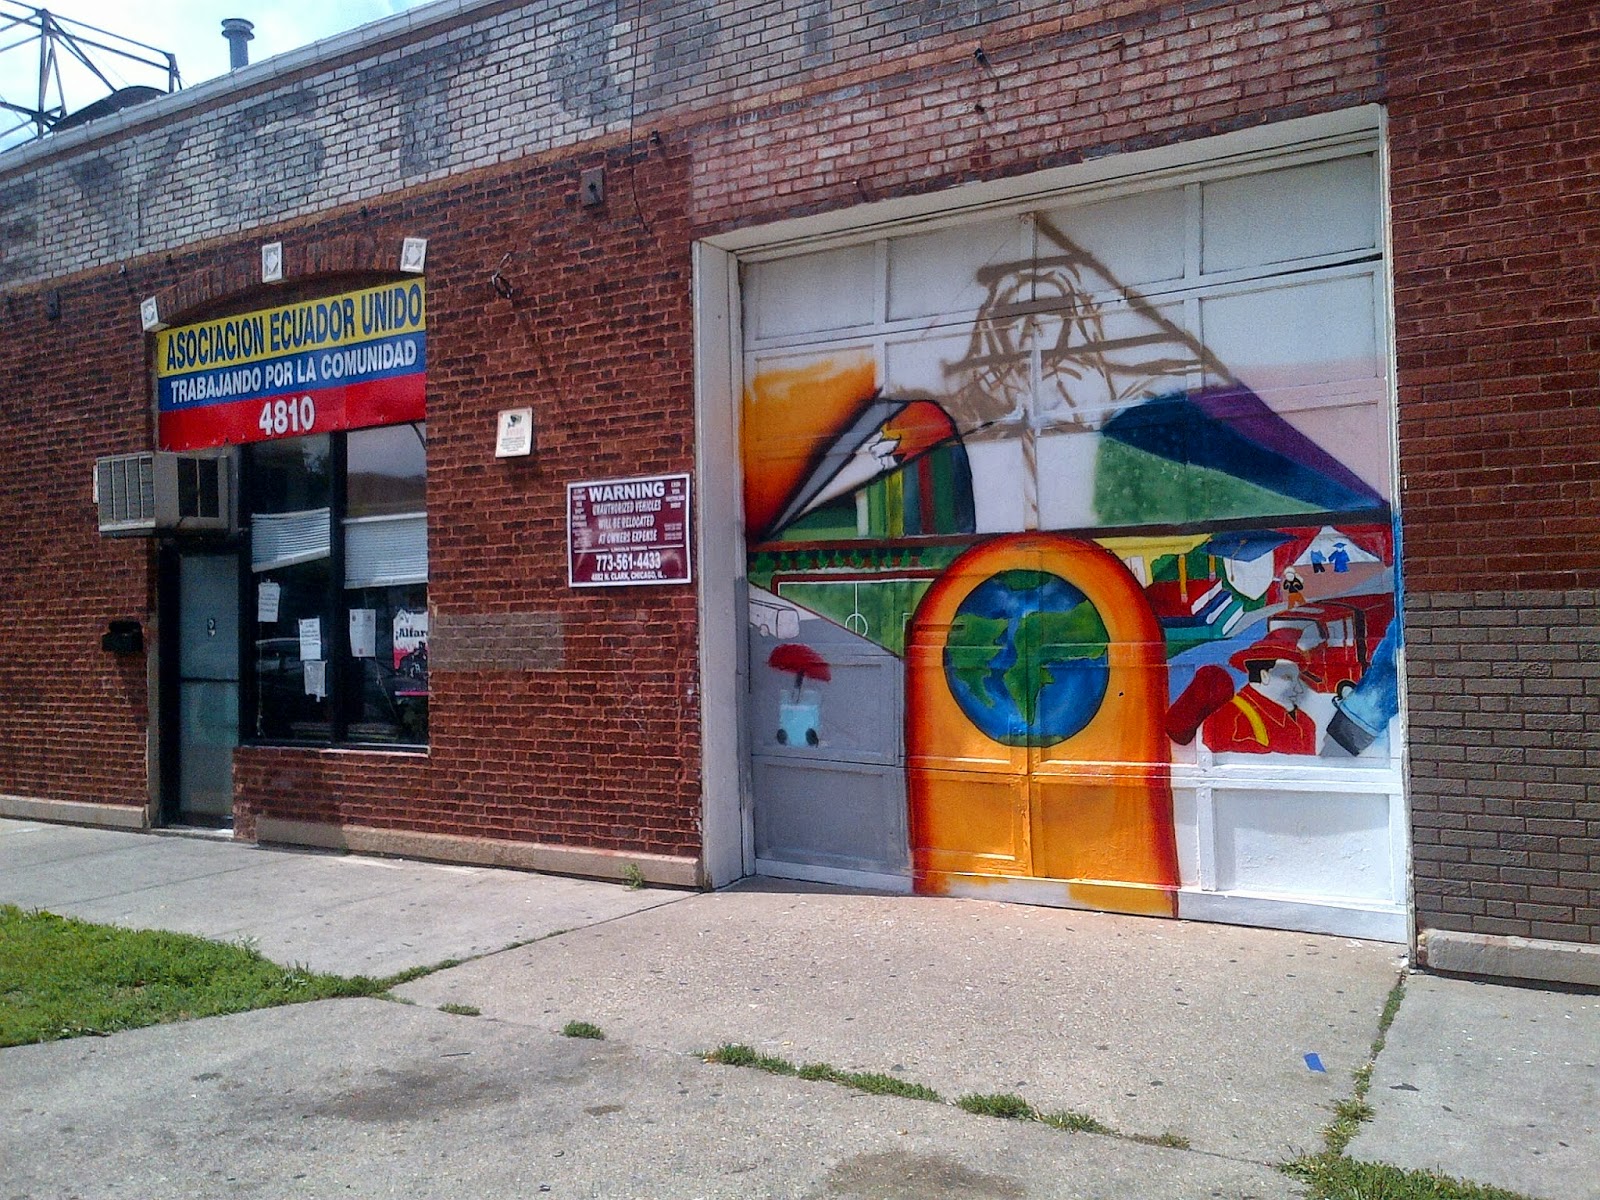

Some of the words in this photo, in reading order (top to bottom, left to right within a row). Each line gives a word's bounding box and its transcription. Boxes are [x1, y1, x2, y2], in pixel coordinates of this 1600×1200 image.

[166, 315, 264, 370] ASOCIACION
[270, 298, 356, 351] ECUADOR
[361, 284, 422, 335] UNIDO
[171, 371, 262, 403] TRABAJANDO
[265, 364, 293, 389] POR
[297, 361, 317, 383] LA
[321, 340, 417, 378] COMUNIDAD
[258, 397, 315, 435] 4810
[588, 482, 665, 502] WARNING
[592, 501, 634, 516] UNAUTHORIZED
[635, 500, 661, 513] VEHICLES
[598, 517, 611, 530] WILL
[622, 514, 655, 529] RELOCATED
[632, 529, 657, 542] EXPENSE
